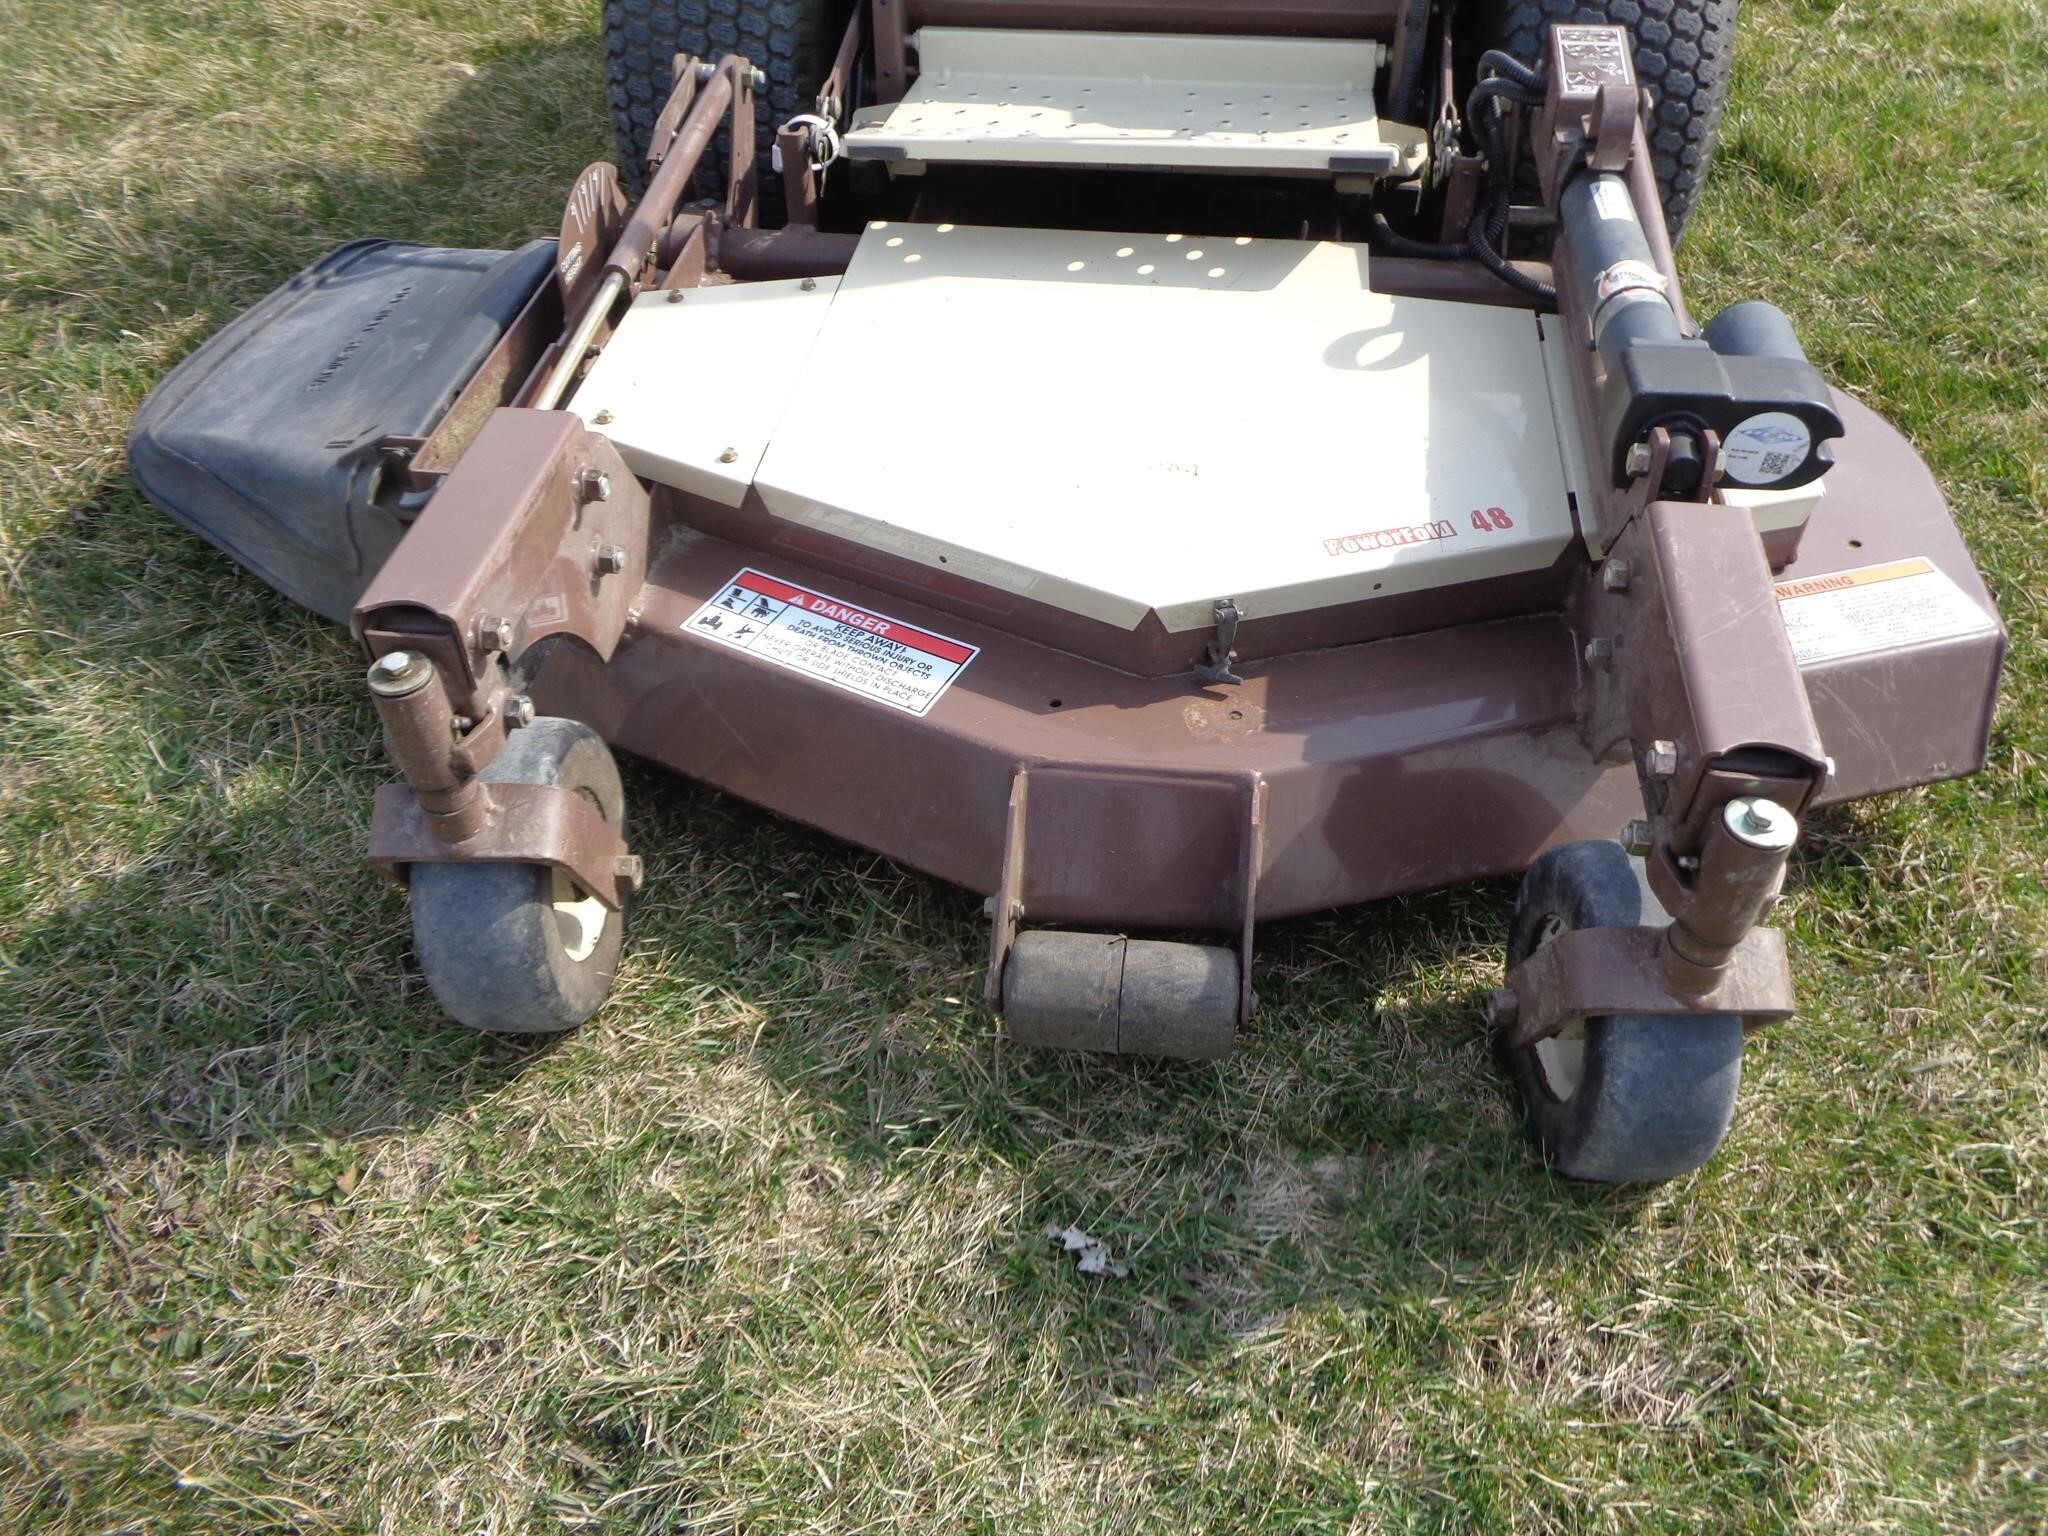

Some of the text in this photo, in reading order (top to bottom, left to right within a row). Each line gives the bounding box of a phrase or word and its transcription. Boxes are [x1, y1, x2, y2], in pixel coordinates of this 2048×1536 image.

[1470, 507, 1514, 531] 48
[1777, 576, 1854, 598] WARNING
[809, 599, 890, 634] DANGER
[833, 623, 865, 637] KEEP
[765, 642, 793, 656] CHUTE
[810, 659, 831, 671] SIDE
[832, 667, 868, 684] SHIELDS
[786, 624, 931, 679] DEATH FROM THROWN OBJECTS
[797, 619, 932, 671] TO AVOID SERIOUS INJURY OR
[804, 639, 898, 676] OR BLADE CONTACT
[793, 644, 832, 662] OPERATE
[833, 660, 875, 676] WITHOUT
[875, 674, 932, 698] DISCHARGE
